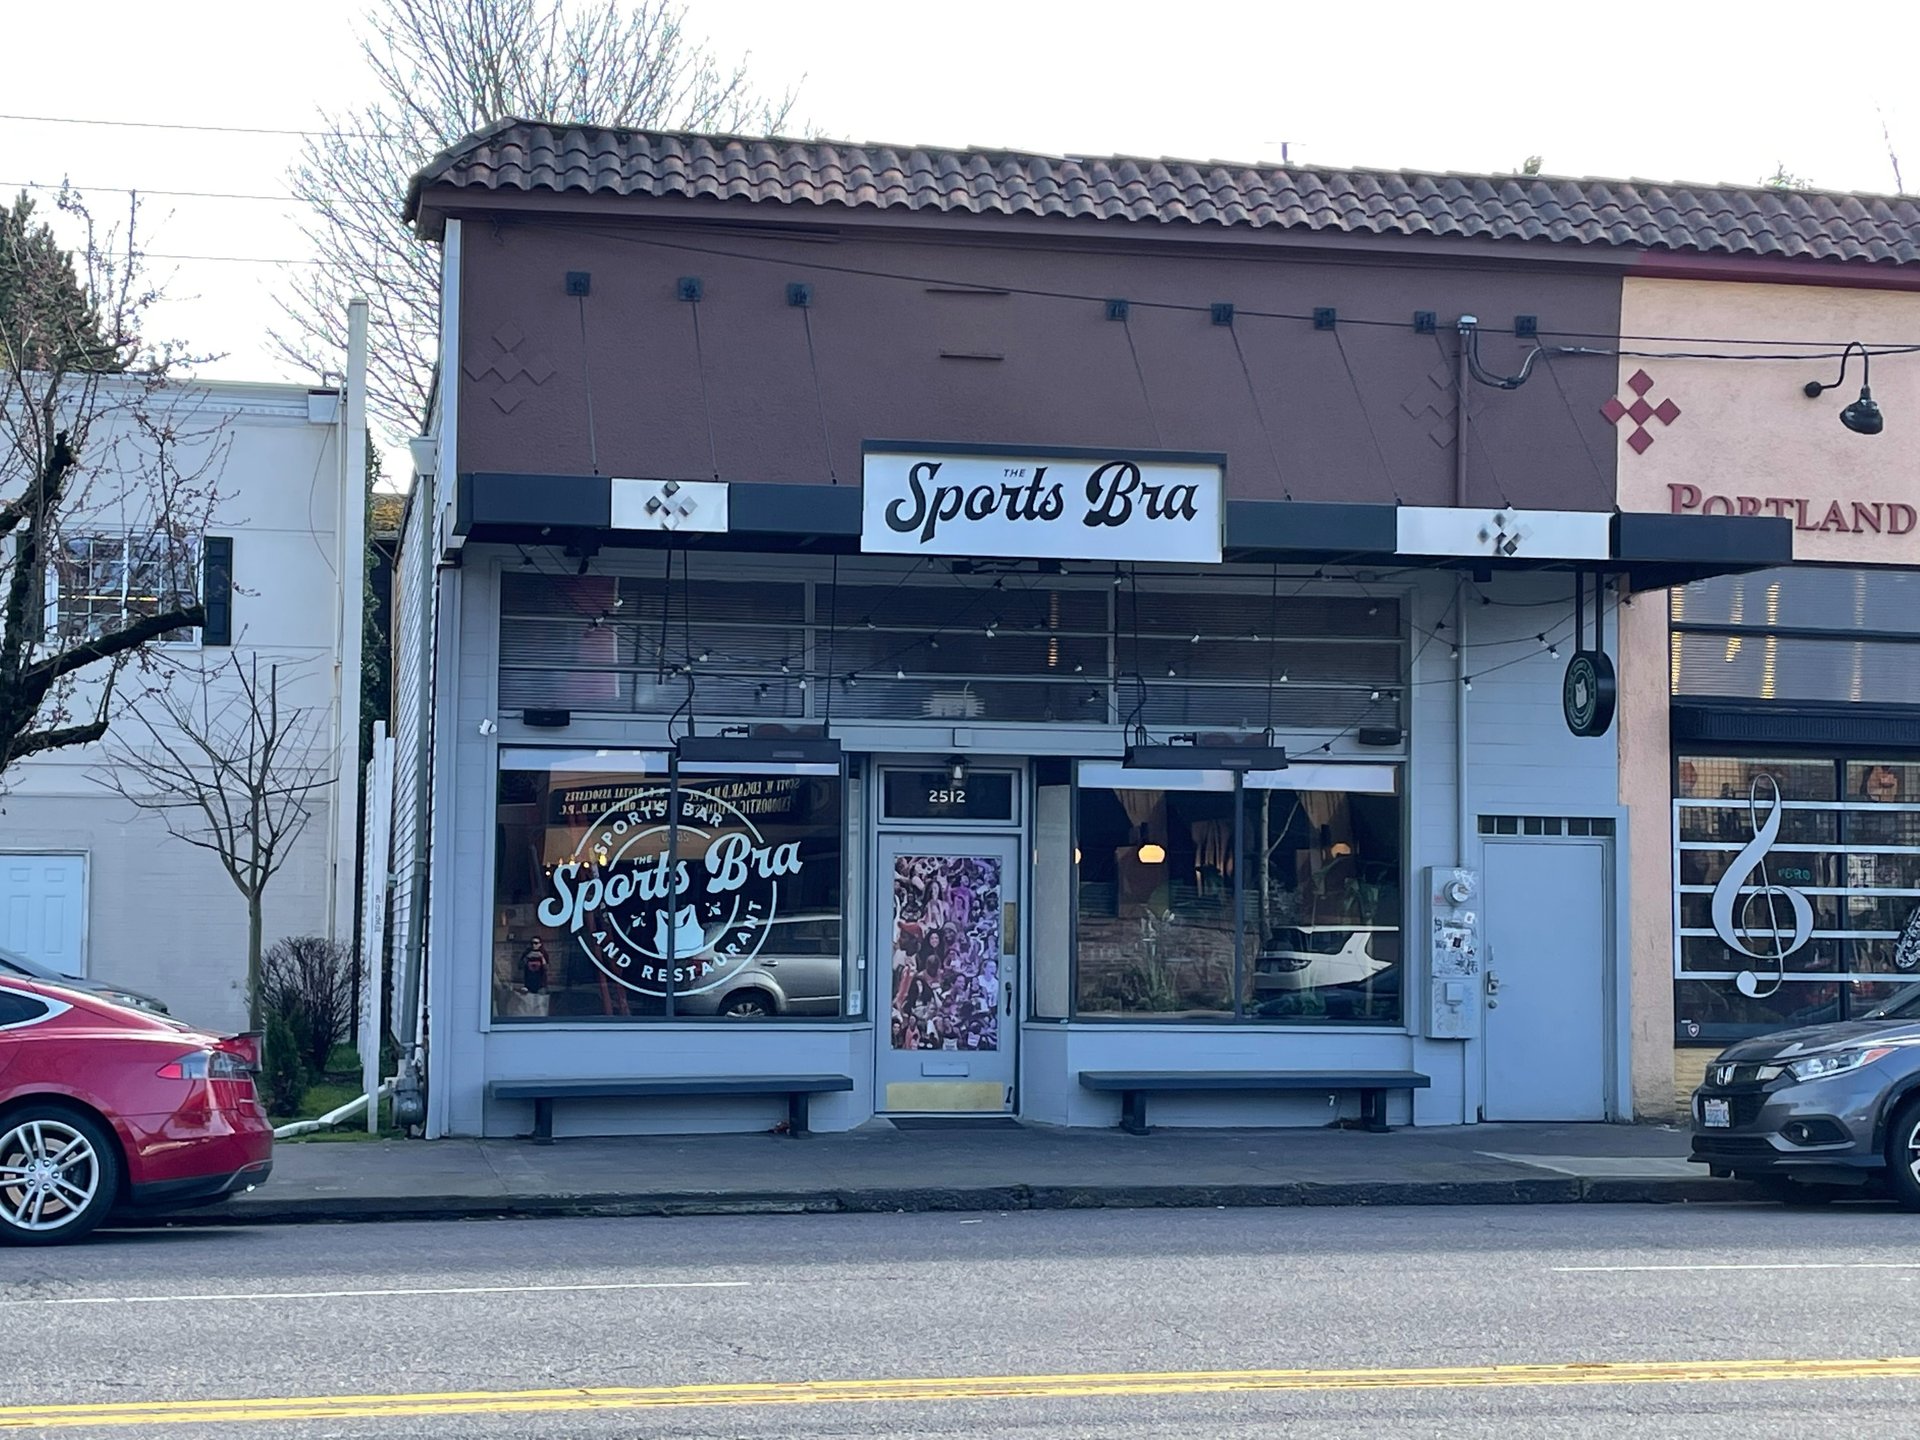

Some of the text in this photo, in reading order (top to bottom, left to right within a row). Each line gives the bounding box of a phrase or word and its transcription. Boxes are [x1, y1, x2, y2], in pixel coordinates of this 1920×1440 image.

[1003, 468, 1026, 478] THE
[885, 461, 1199, 544] Sports Bra
[928, 790, 966, 804] 2512
[593, 803, 723, 856] SPORTS BAR
[537, 832, 803, 933] Sports Bra
[632, 854, 653, 865] THE
[591, 900, 763, 983] AND RESTAURANT
